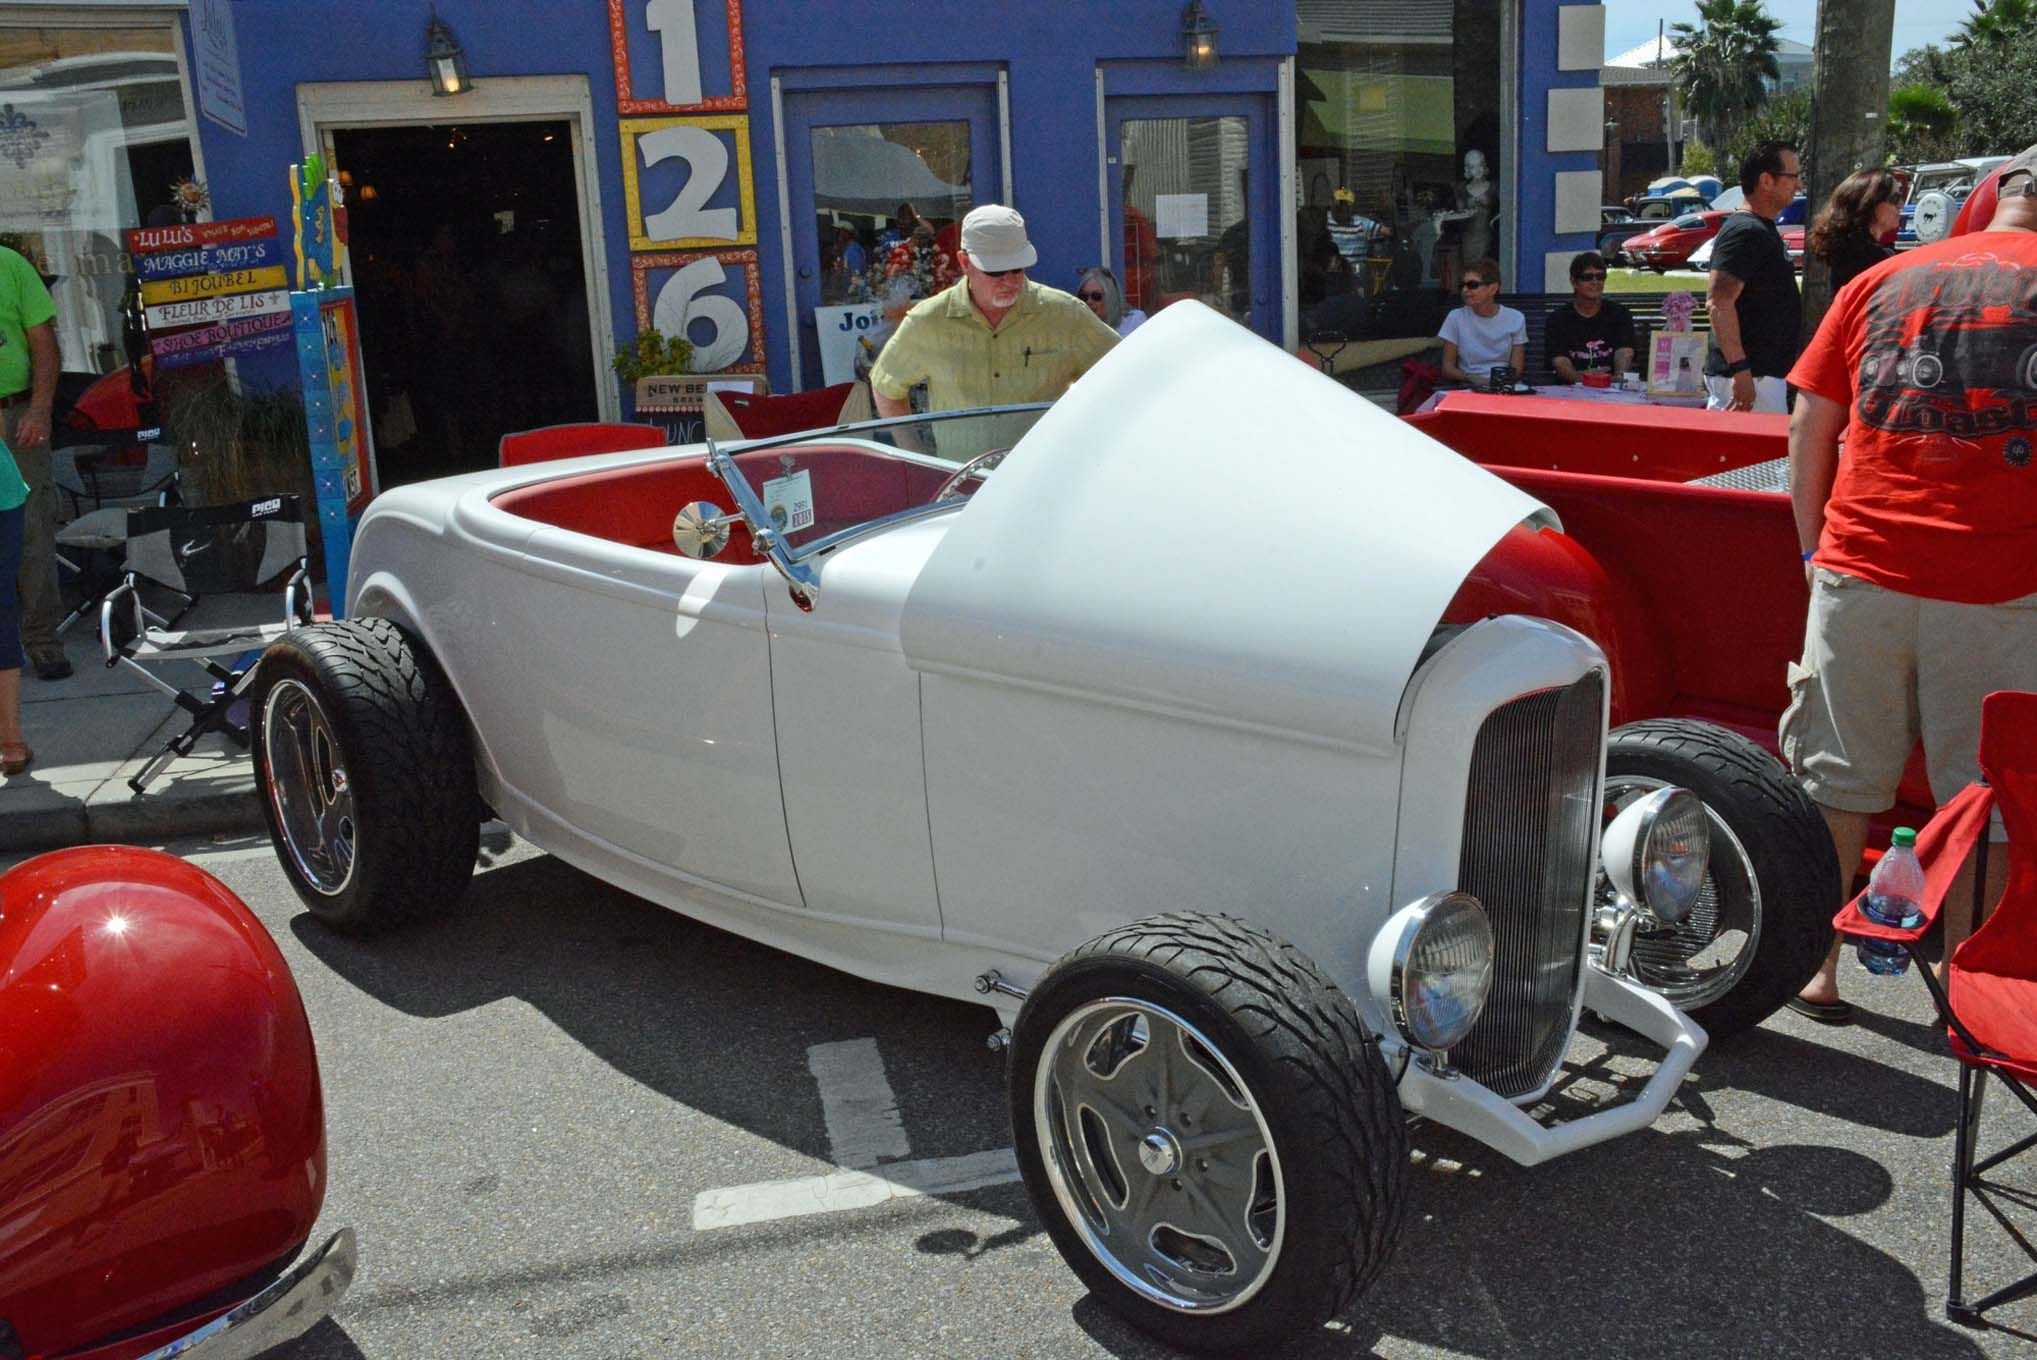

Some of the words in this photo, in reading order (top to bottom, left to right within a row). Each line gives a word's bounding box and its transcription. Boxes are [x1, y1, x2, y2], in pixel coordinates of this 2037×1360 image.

[144, 251, 208, 273] MAGGIE
[159, 302, 210, 320] FLEUR
[214, 298, 234, 314] DE
[240, 294, 265, 309] LIS
[204, 314, 281, 341] BOUTIQUE
[649, 383, 681, 394] NEW
[252, 498, 281, 515] PICO
